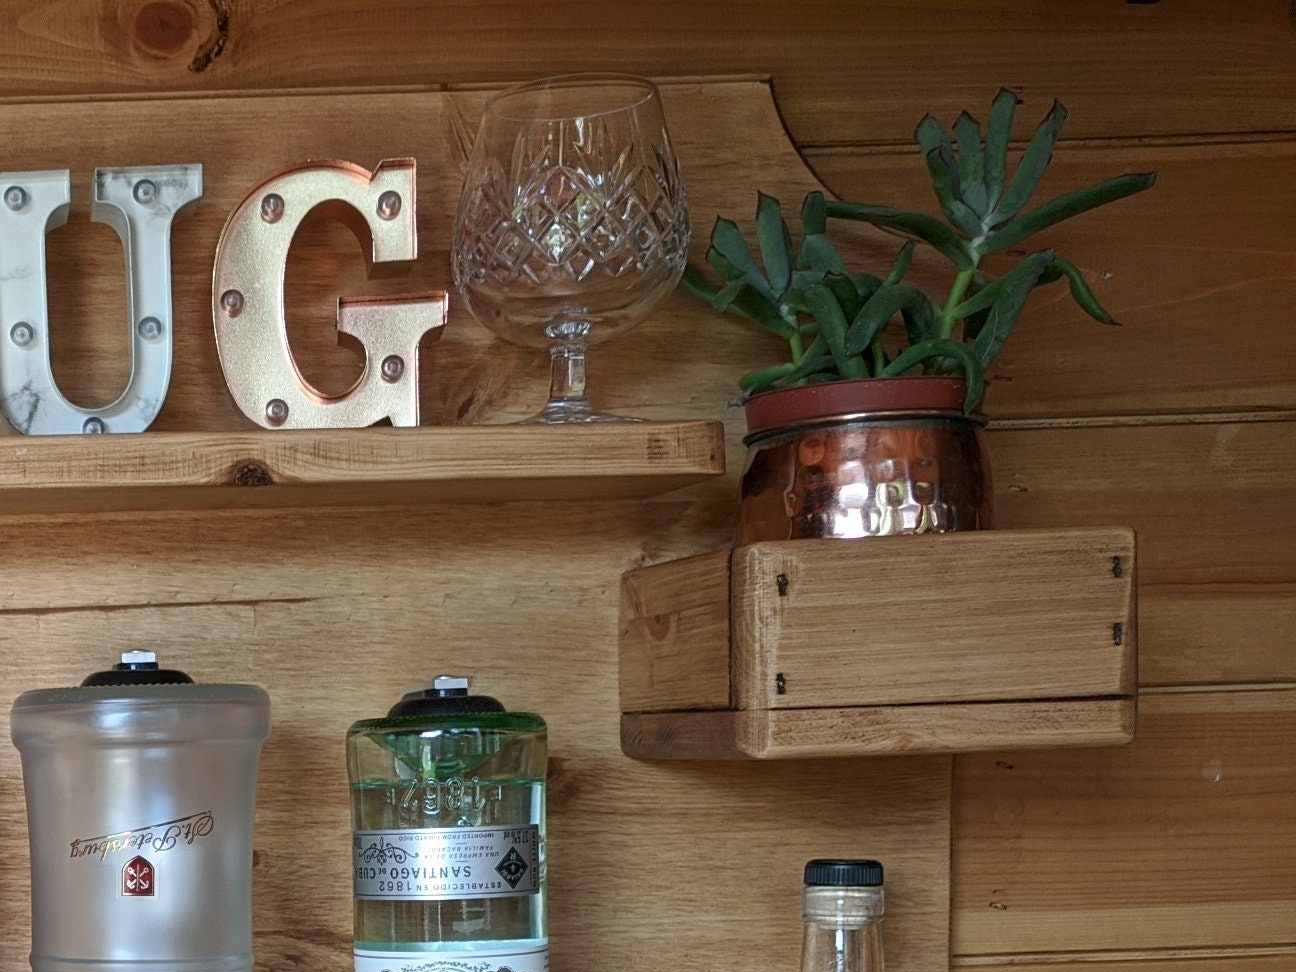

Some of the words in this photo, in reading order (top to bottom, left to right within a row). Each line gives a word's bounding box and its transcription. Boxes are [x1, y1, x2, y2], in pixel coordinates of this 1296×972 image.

[70, 824, 181, 862] Petersburg
[354, 868, 376, 879] CUBA
[390, 865, 472, 880] SANTIAGO
[378, 881, 412, 892] 1862
[433, 881, 501, 890] ESTABLECIDO
